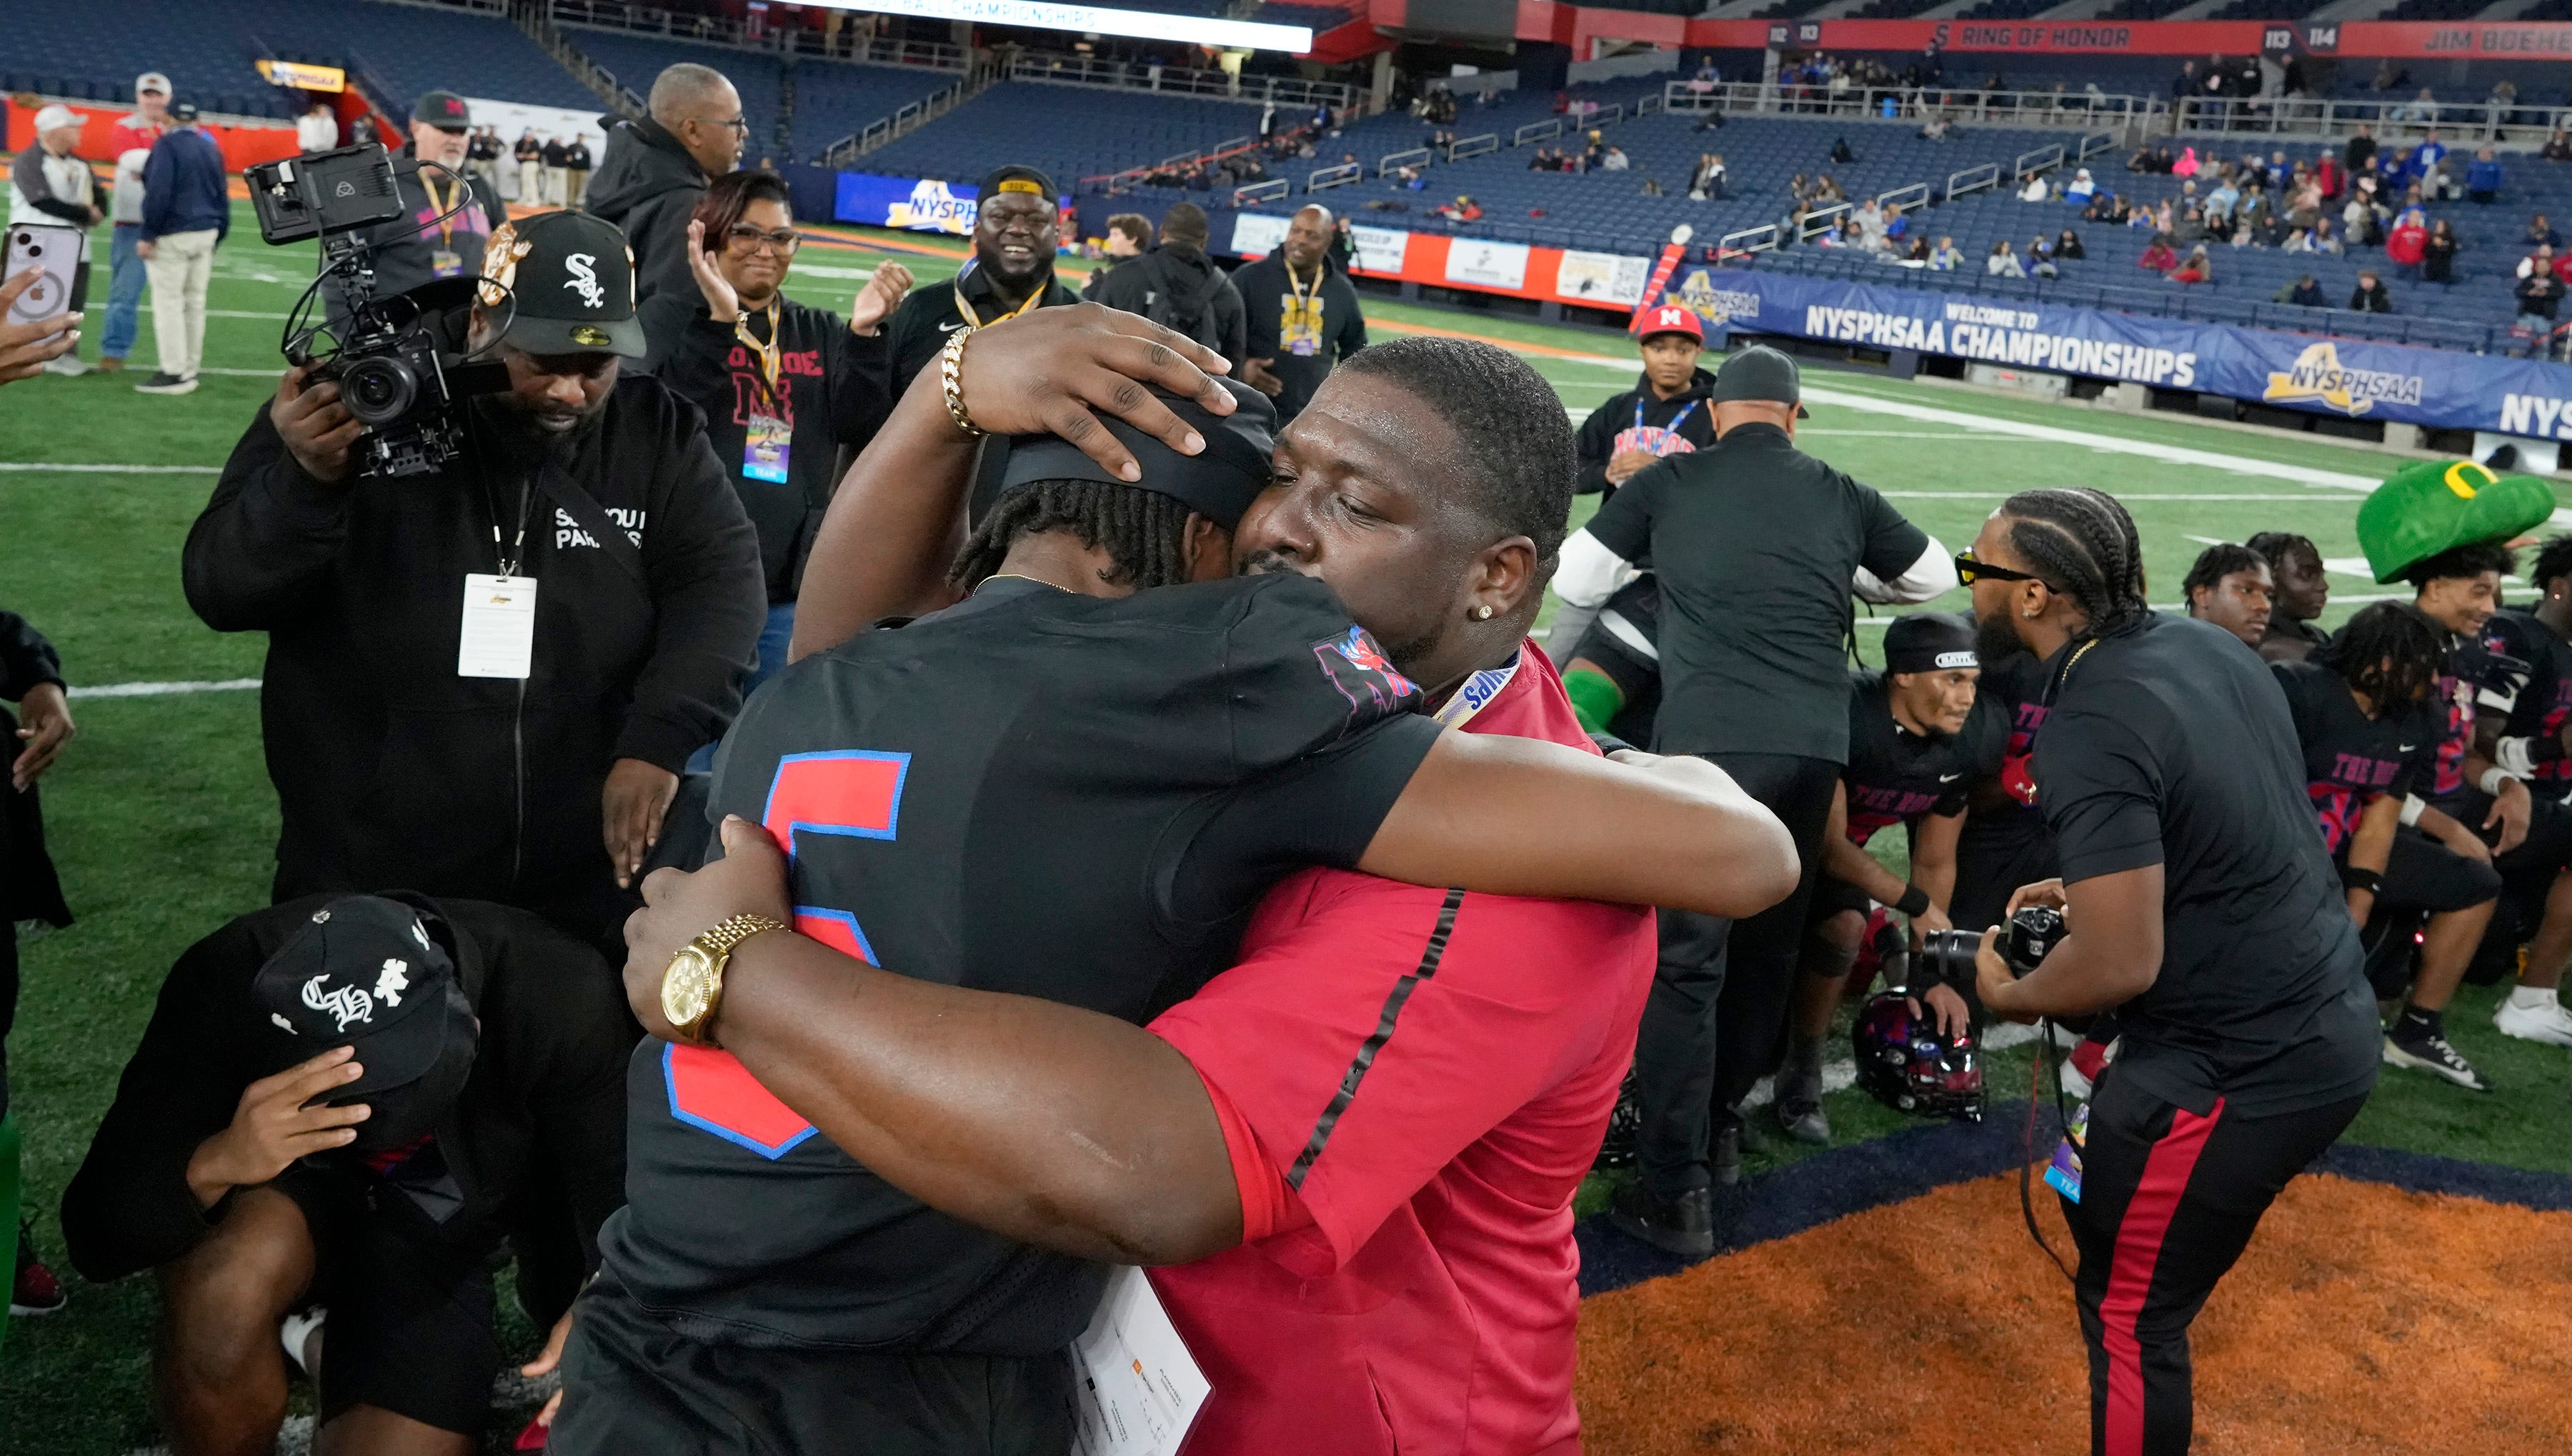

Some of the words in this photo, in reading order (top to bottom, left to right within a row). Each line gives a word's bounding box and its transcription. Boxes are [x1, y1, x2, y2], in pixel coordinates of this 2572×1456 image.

[950, 0, 1096, 27] CHAMPIONSHIPS
[1961, 26, 2011, 46] RING
[2016, 26, 2045, 47] OF
[2050, 26, 2130, 47] HONOR
[2266, 29, 2291, 49] 113
[2309, 27, 2336, 46] 114
[2425, 30, 2472, 51] JIM
[1660, 309, 1681, 326] M
[1946, 302, 2016, 328] WELCOME
[2018, 311, 2039, 331] TO
[1805, 304, 1945, 354] NYSPHSAA
[1950, 324, 2198, 388] CHAMPIONSHIPS
[2290, 365, 2422, 404] NYSPHSAA
[2060, 1177, 2080, 1199] TEA
